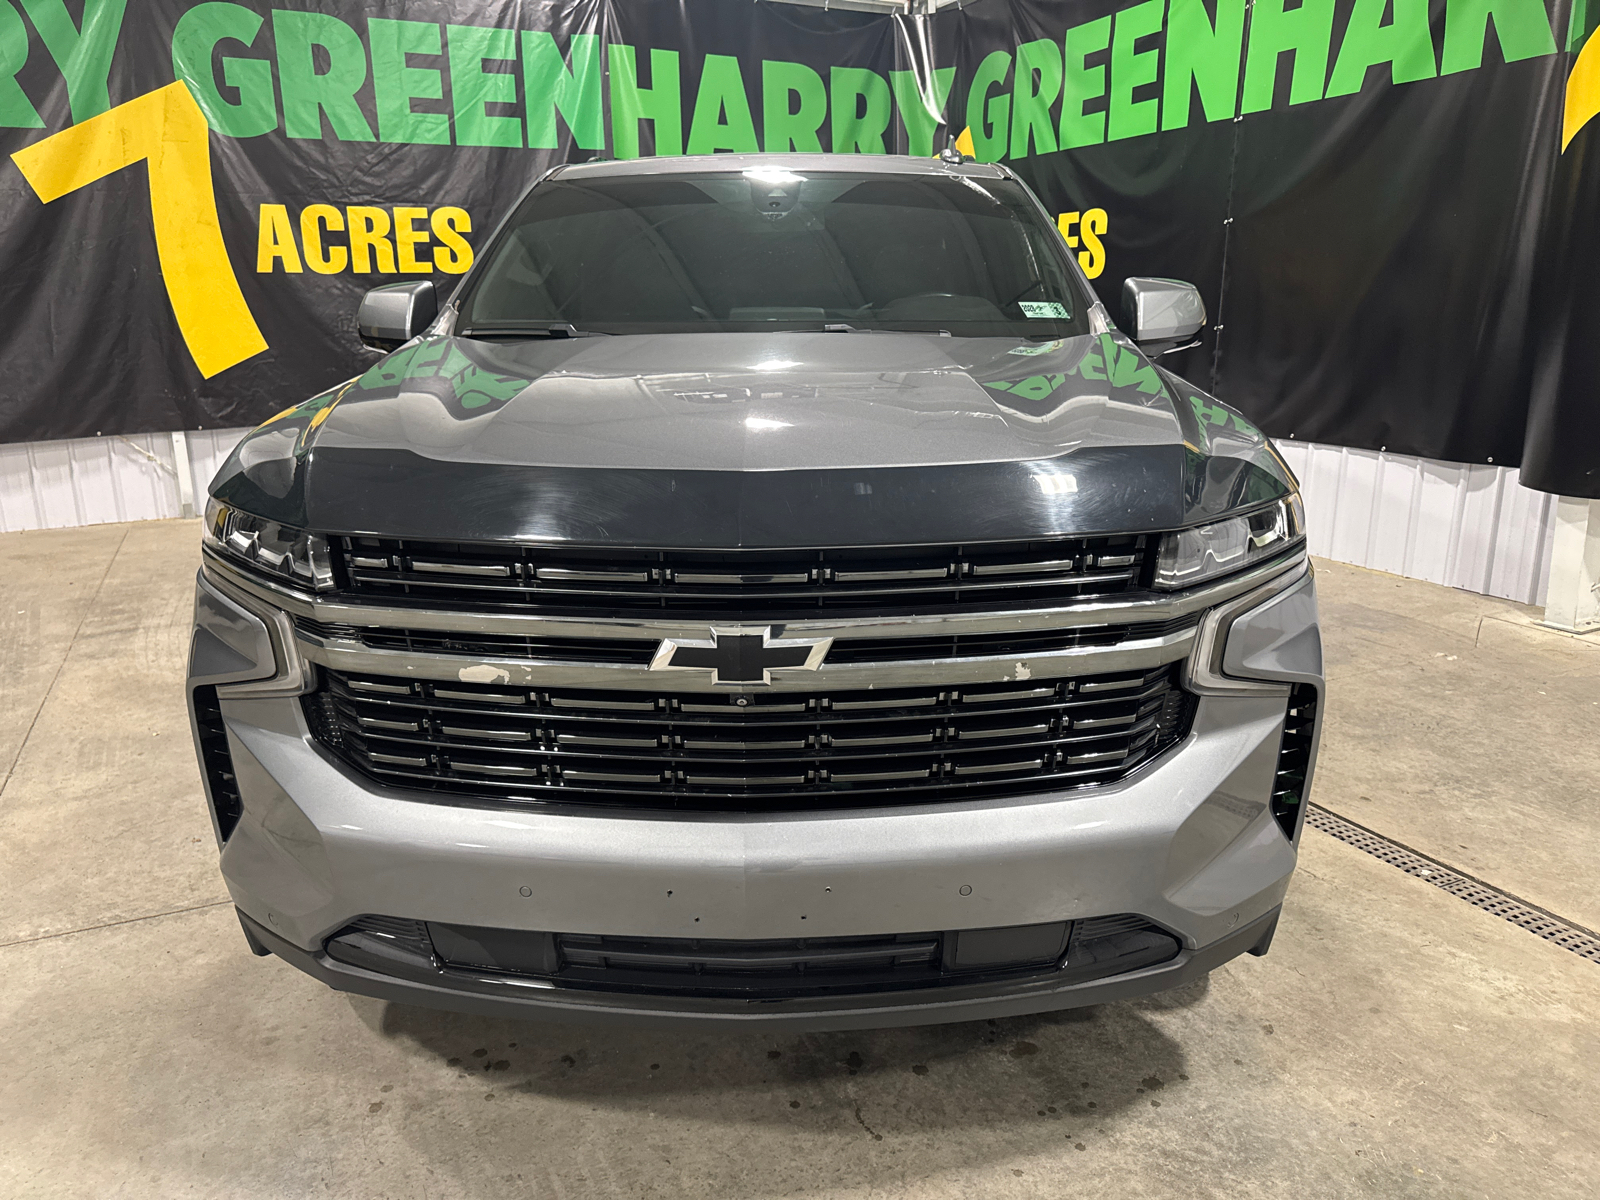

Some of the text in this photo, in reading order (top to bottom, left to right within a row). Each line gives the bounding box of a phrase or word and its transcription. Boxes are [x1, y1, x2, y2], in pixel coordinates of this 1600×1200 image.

[172, 2, 605, 150] GREEN
[608, 0, 1247, 162] HARRY GREEN
[10, 79, 474, 379] 7 ACRES
[1050, 207, 1108, 280] ES
